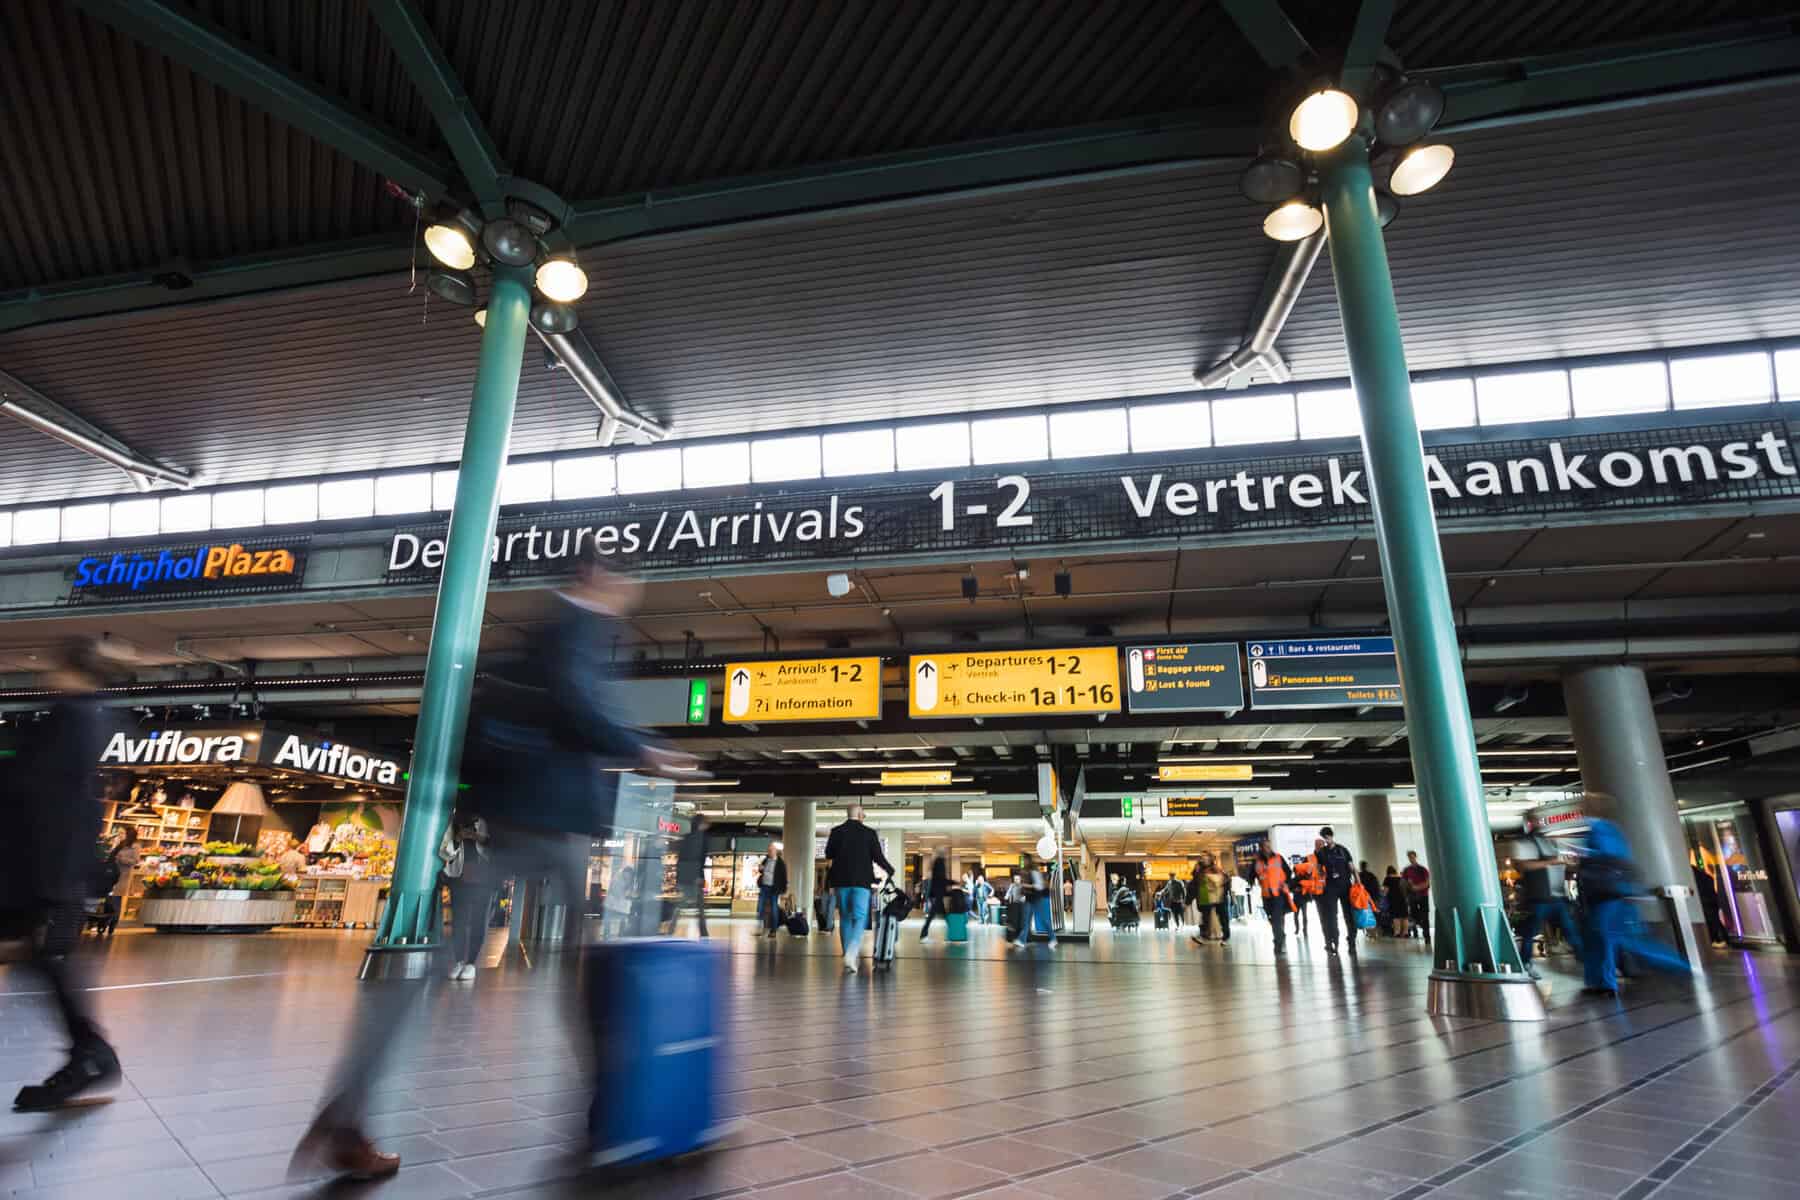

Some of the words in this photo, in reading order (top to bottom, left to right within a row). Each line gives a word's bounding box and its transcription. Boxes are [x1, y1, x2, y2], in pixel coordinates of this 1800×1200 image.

[928, 475, 1034, 532] 1-2
[1120, 458, 1368, 518] Vertrek
[1422, 431, 1797, 499] Aankomst
[1288, 645, 1306, 654] Bars
[1315, 643, 1361, 652] restaurants
[777, 664, 827, 676] Arrivals
[830, 663, 863, 683] 1-2
[966, 655, 1043, 669] Departures
[1046, 655, 1081, 676] 1-2
[1157, 664, 1192, 674] Baggage
[1194, 664, 1224, 673] storage
[1158, 680, 1176, 689] Lost
[1186, 680, 1210, 688] found
[1282, 675, 1324, 684] Panorama
[966, 691, 1026, 705] Check-in
[1030, 686, 1056, 707] 1a
[1065, 683, 1115, 705] 1-16
[1347, 690, 1375, 699] Toilets
[776, 697, 853, 711] Information
[100, 730, 243, 763] Aviflora
[273, 734, 397, 785] Aviflora
